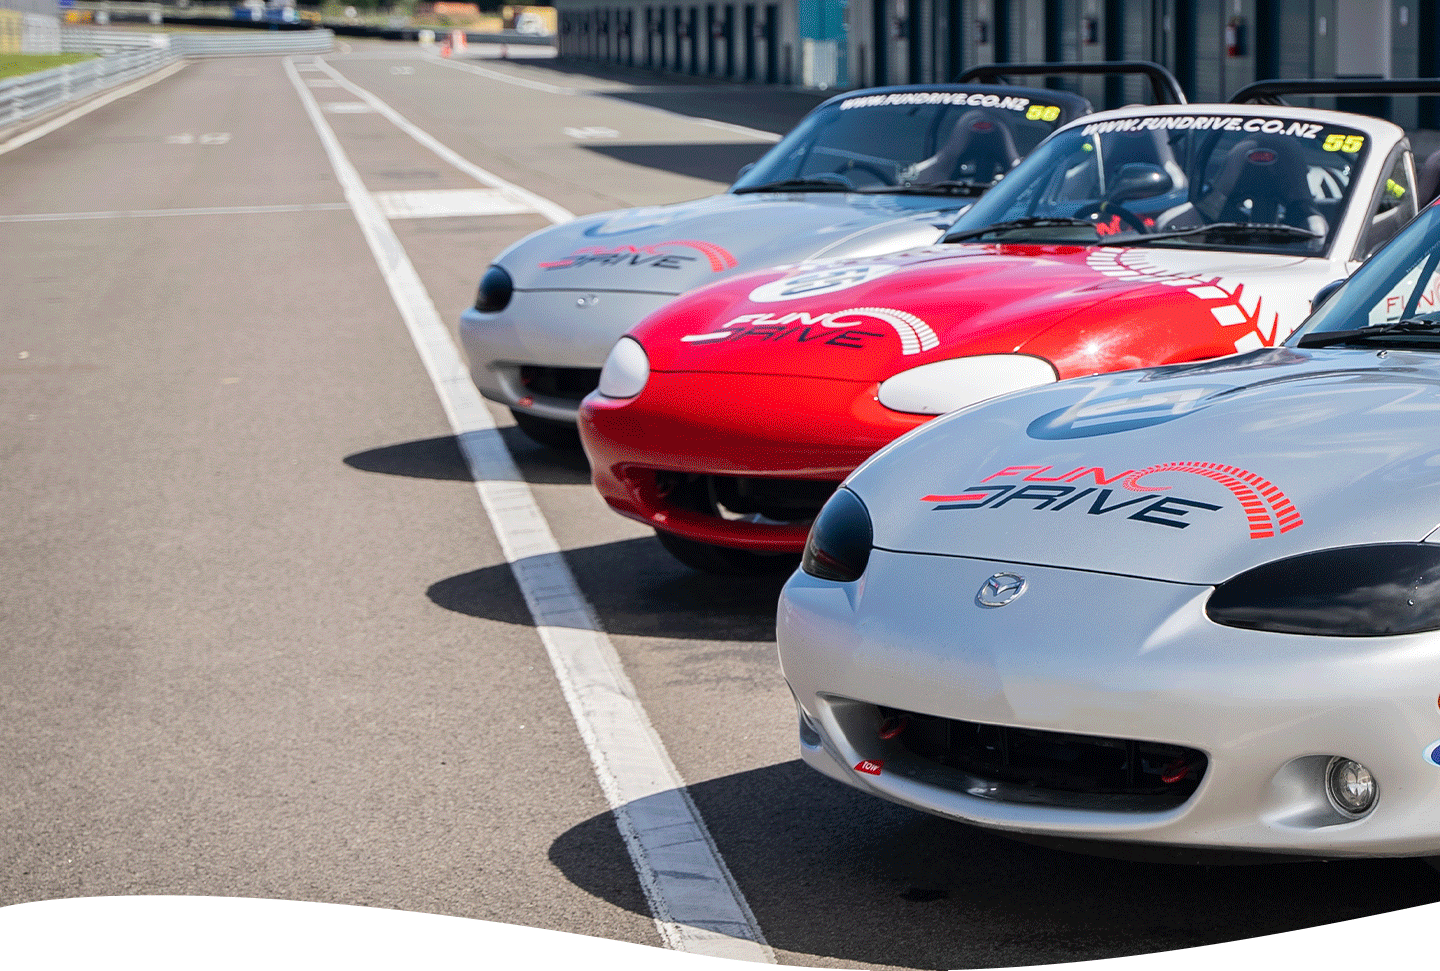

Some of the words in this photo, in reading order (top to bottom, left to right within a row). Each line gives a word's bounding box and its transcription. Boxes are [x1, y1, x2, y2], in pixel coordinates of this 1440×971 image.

[840, 92, 1029, 111] WWW.FUNDRIVE.CO.NZ
[1081, 116, 1324, 139] WWW.FUNDRIVE.CO.NZ
[1322, 134, 1364, 153] 55
[920, 484, 1224, 530] DRIVE
[862, 760, 880, 772] TOW
